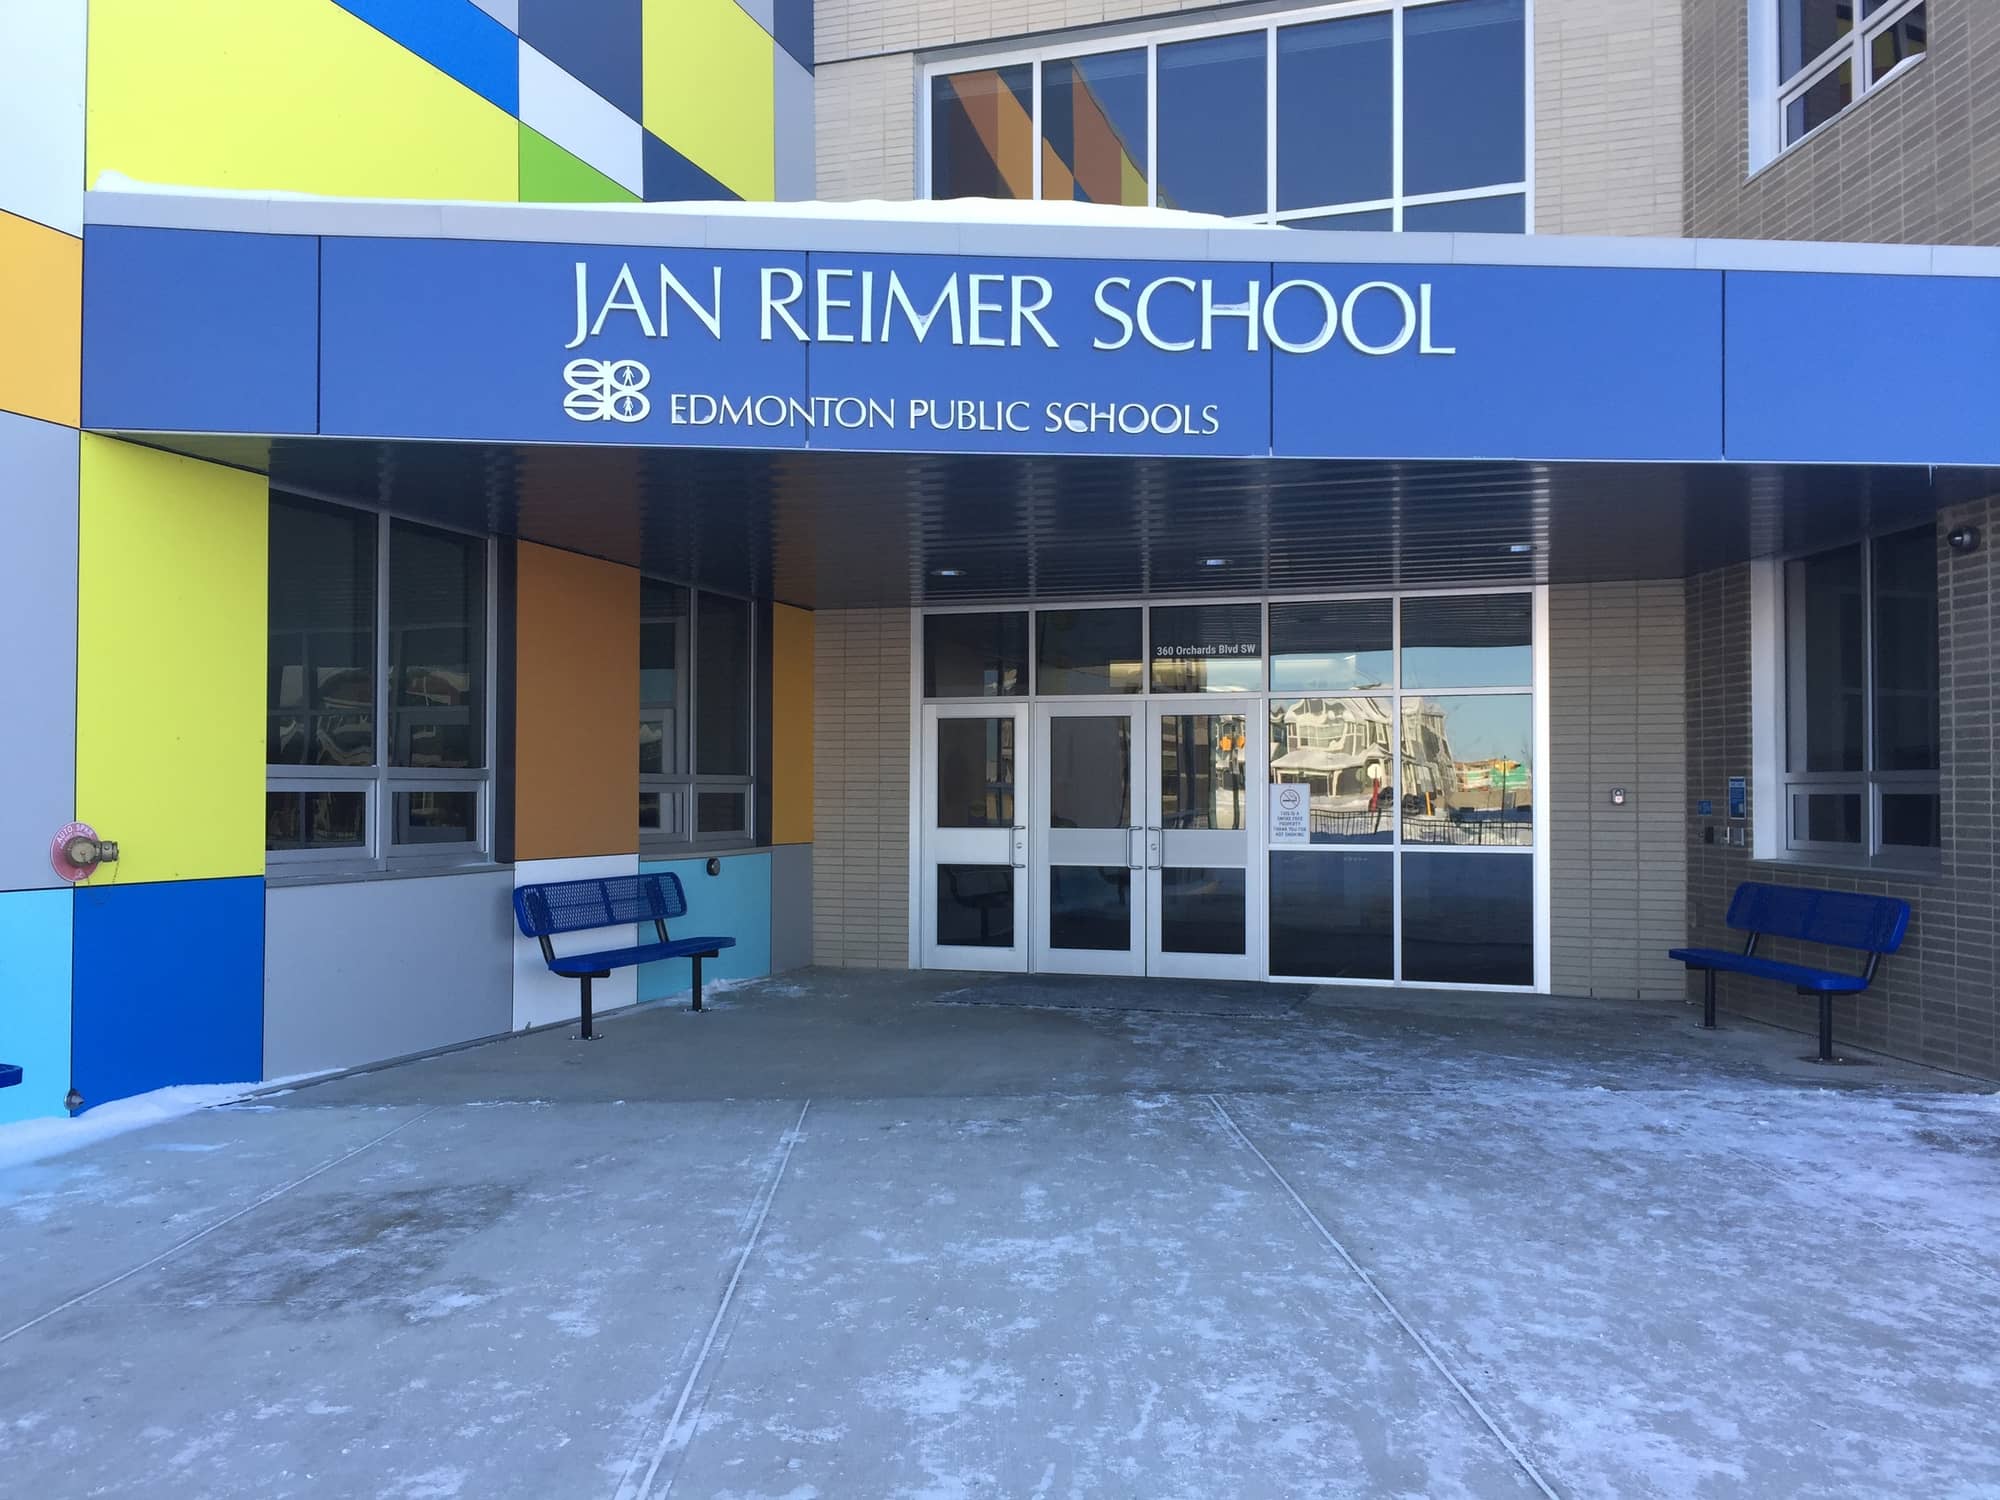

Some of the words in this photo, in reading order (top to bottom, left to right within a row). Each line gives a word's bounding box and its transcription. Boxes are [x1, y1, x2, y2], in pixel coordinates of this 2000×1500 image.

[565, 262, 722, 348] JAN
[760, 267, 1059, 348] REIMER
[1093, 276, 1456, 355] SCHOOL
[671, 393, 895, 429] EDMONTON
[909, 399, 1030, 432] PUBLIC
[1045, 402, 1219, 435] SCHOOLS
[1156, 646, 1174, 656] 360
[1175, 645, 1217, 656] Orchards
[1218, 644, 1239, 654] Blvd
[1240, 644, 1256, 654] SW
[57, 825, 73, 843] AUTO
